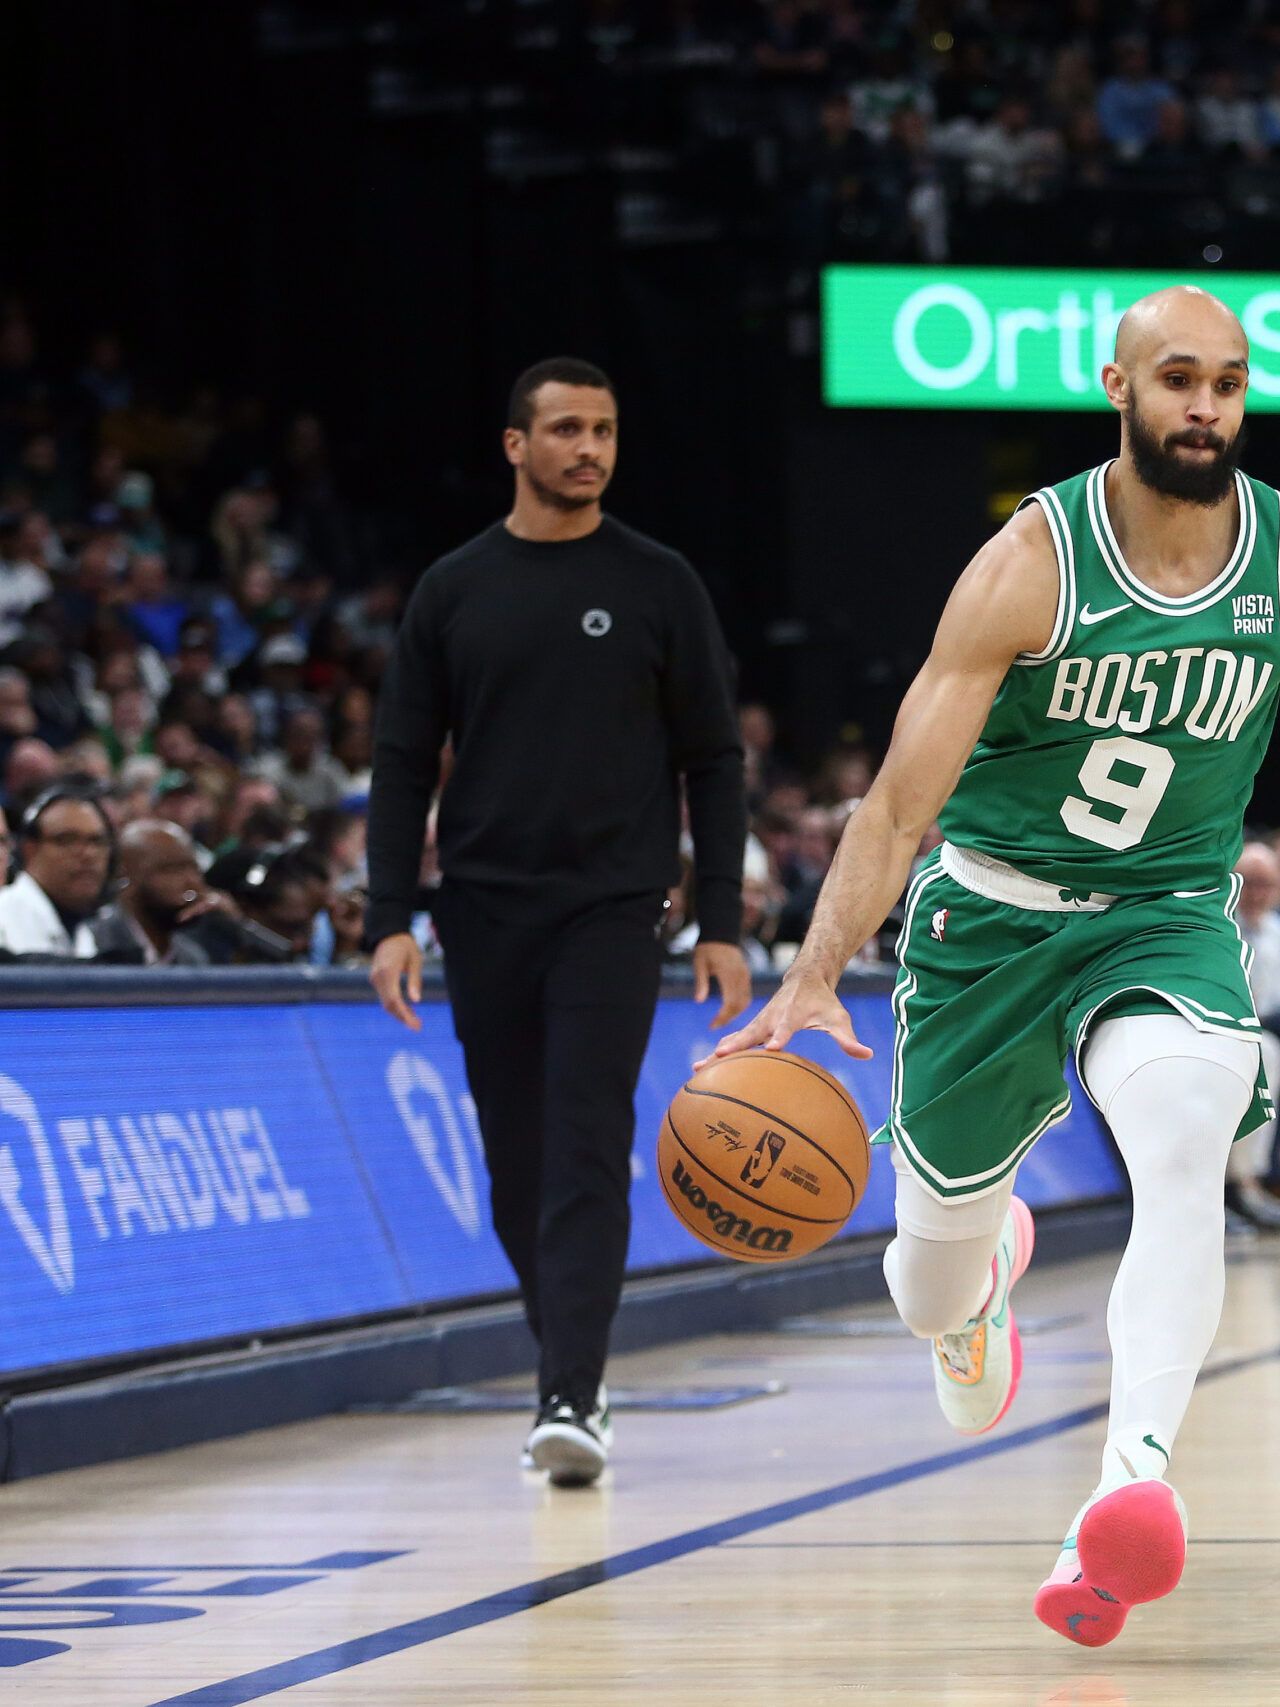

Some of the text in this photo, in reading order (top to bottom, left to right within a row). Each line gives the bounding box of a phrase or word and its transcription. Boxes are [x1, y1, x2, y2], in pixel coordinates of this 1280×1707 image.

[1232, 595, 1274, 617] VISTA
[1234, 618, 1274, 634] PRINT
[1046, 648, 1273, 742] BOSTON
[1059, 735, 1176, 851] 9
[58, 1107, 311, 1240] FANDUEL
[672, 1158, 793, 1252] Wilson
